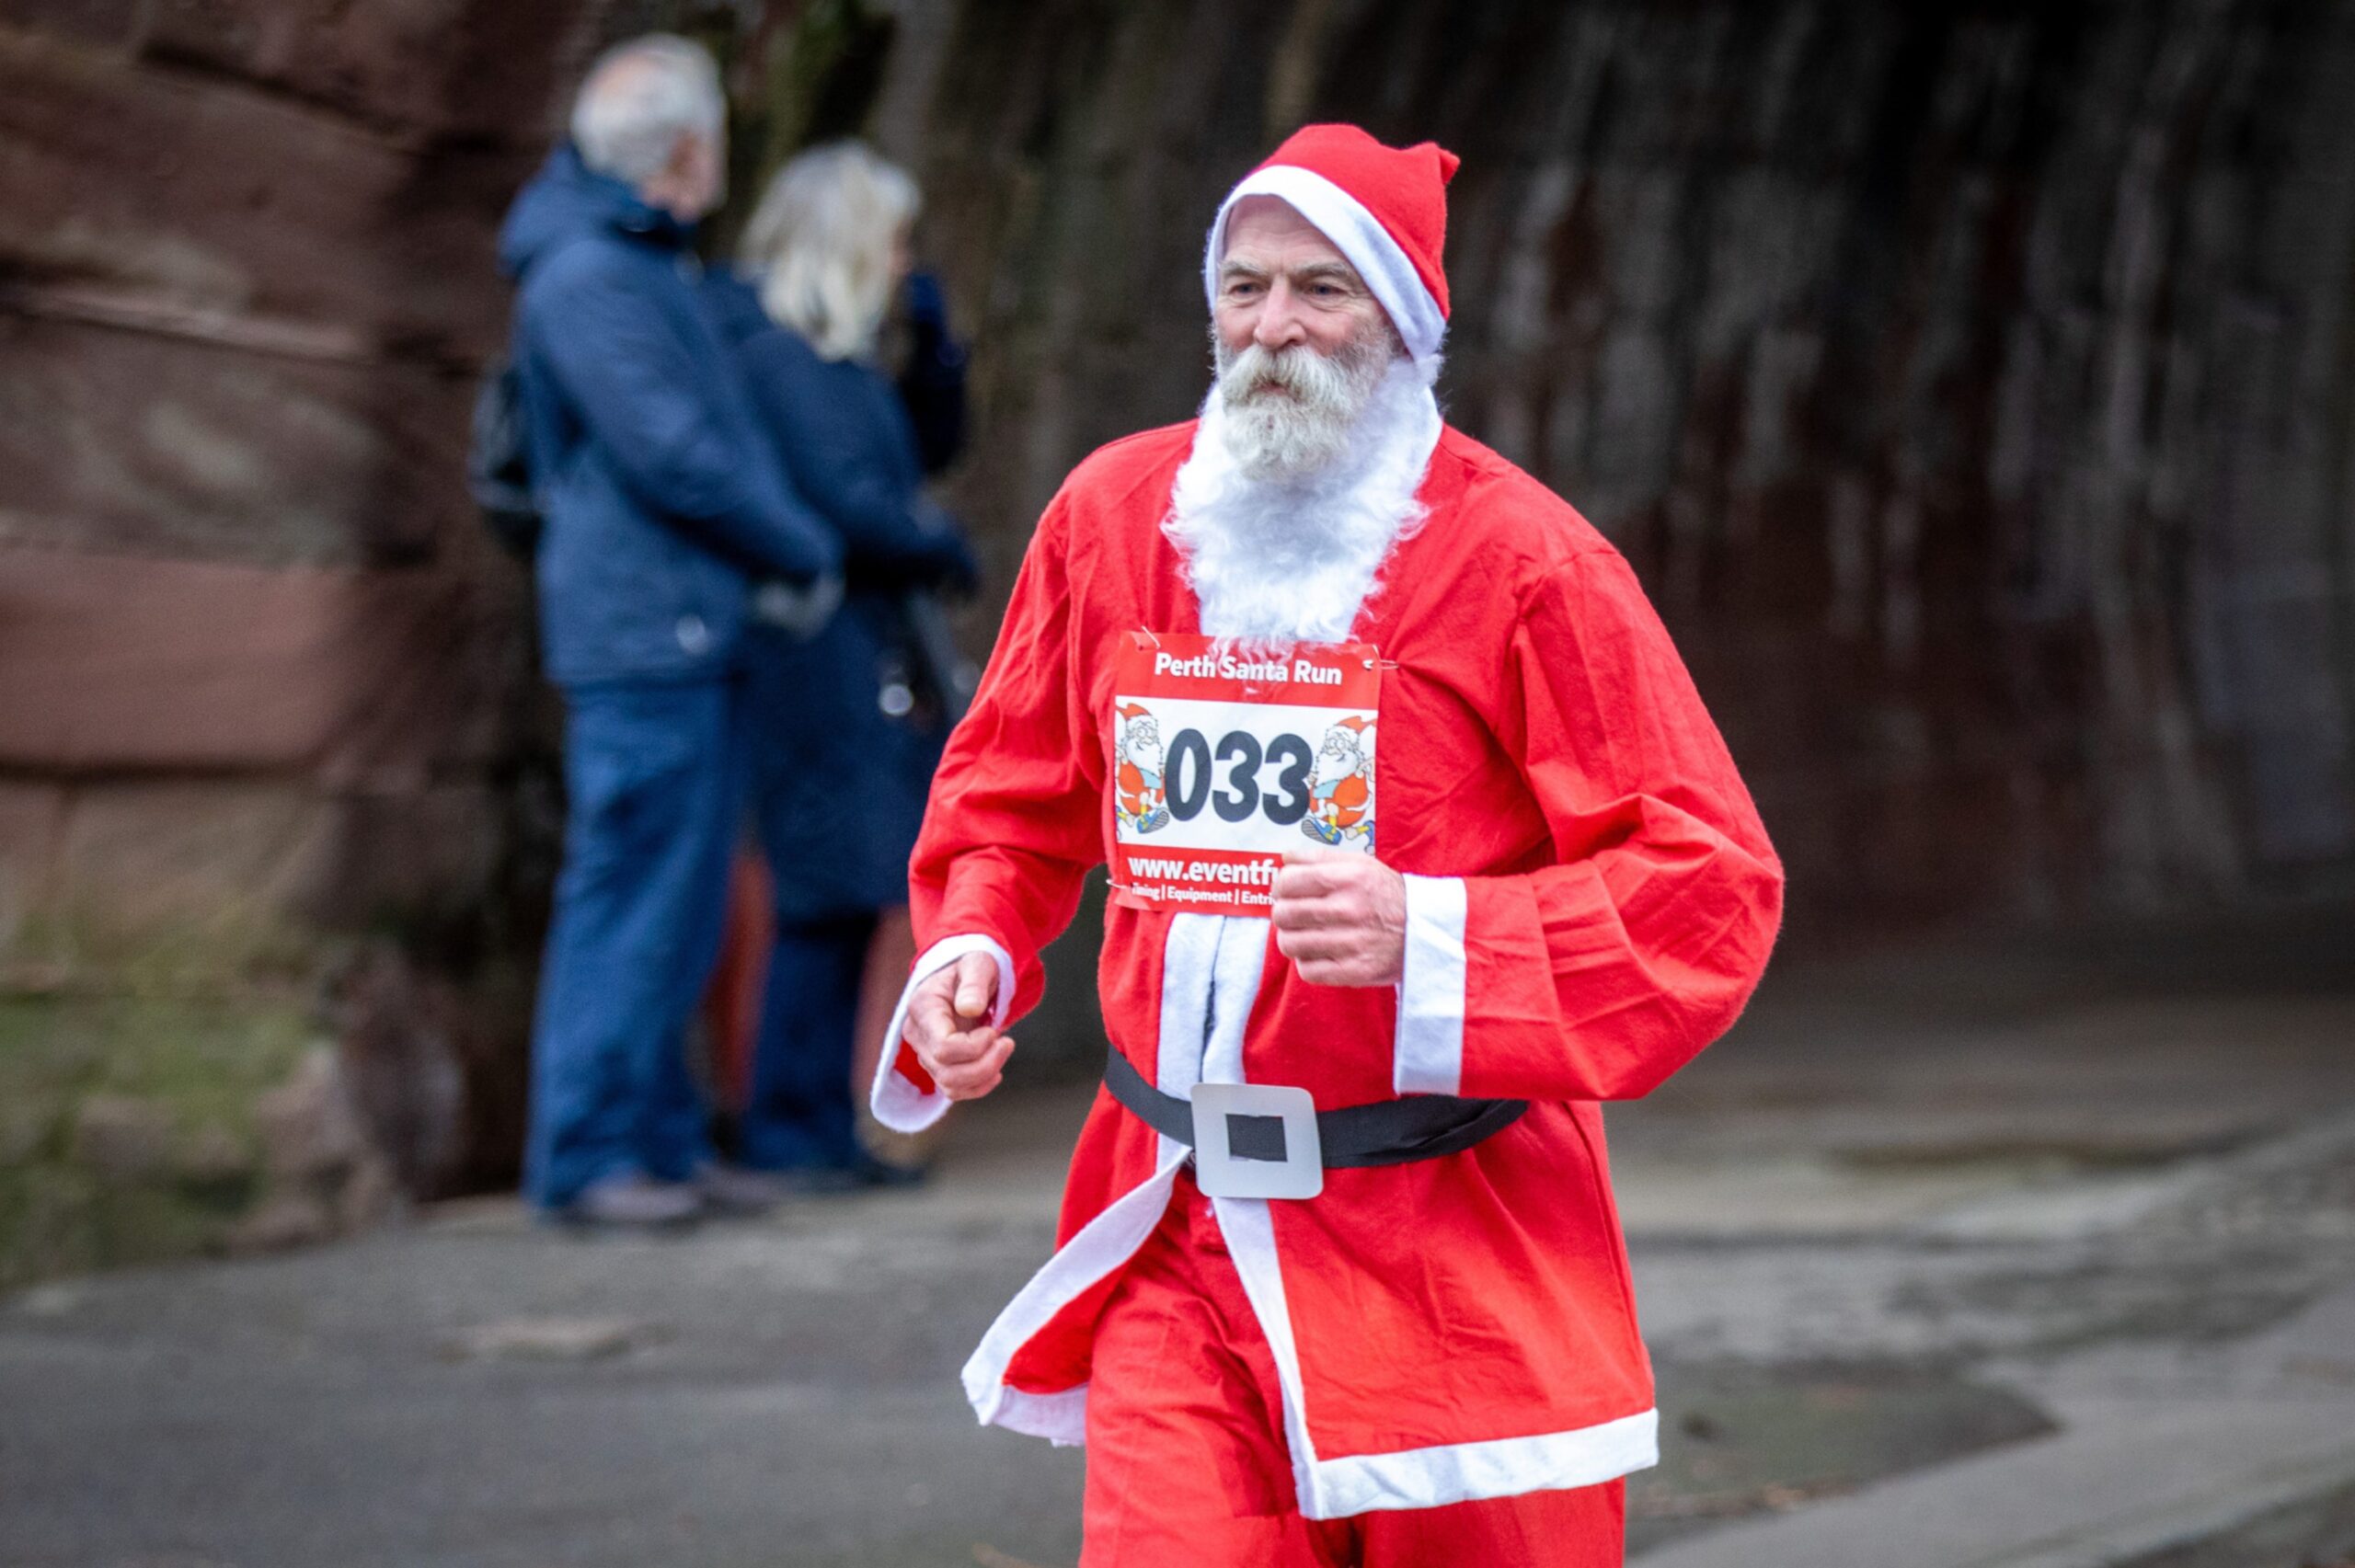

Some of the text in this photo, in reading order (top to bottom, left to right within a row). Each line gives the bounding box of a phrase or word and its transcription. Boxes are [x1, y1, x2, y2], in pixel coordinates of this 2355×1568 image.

[1155, 652, 1343, 685] Perth Santa Run
[1164, 727, 1314, 826] 033
[1167, 886, 1233, 904] Equipment
[1242, 890, 1275, 906] Entri
